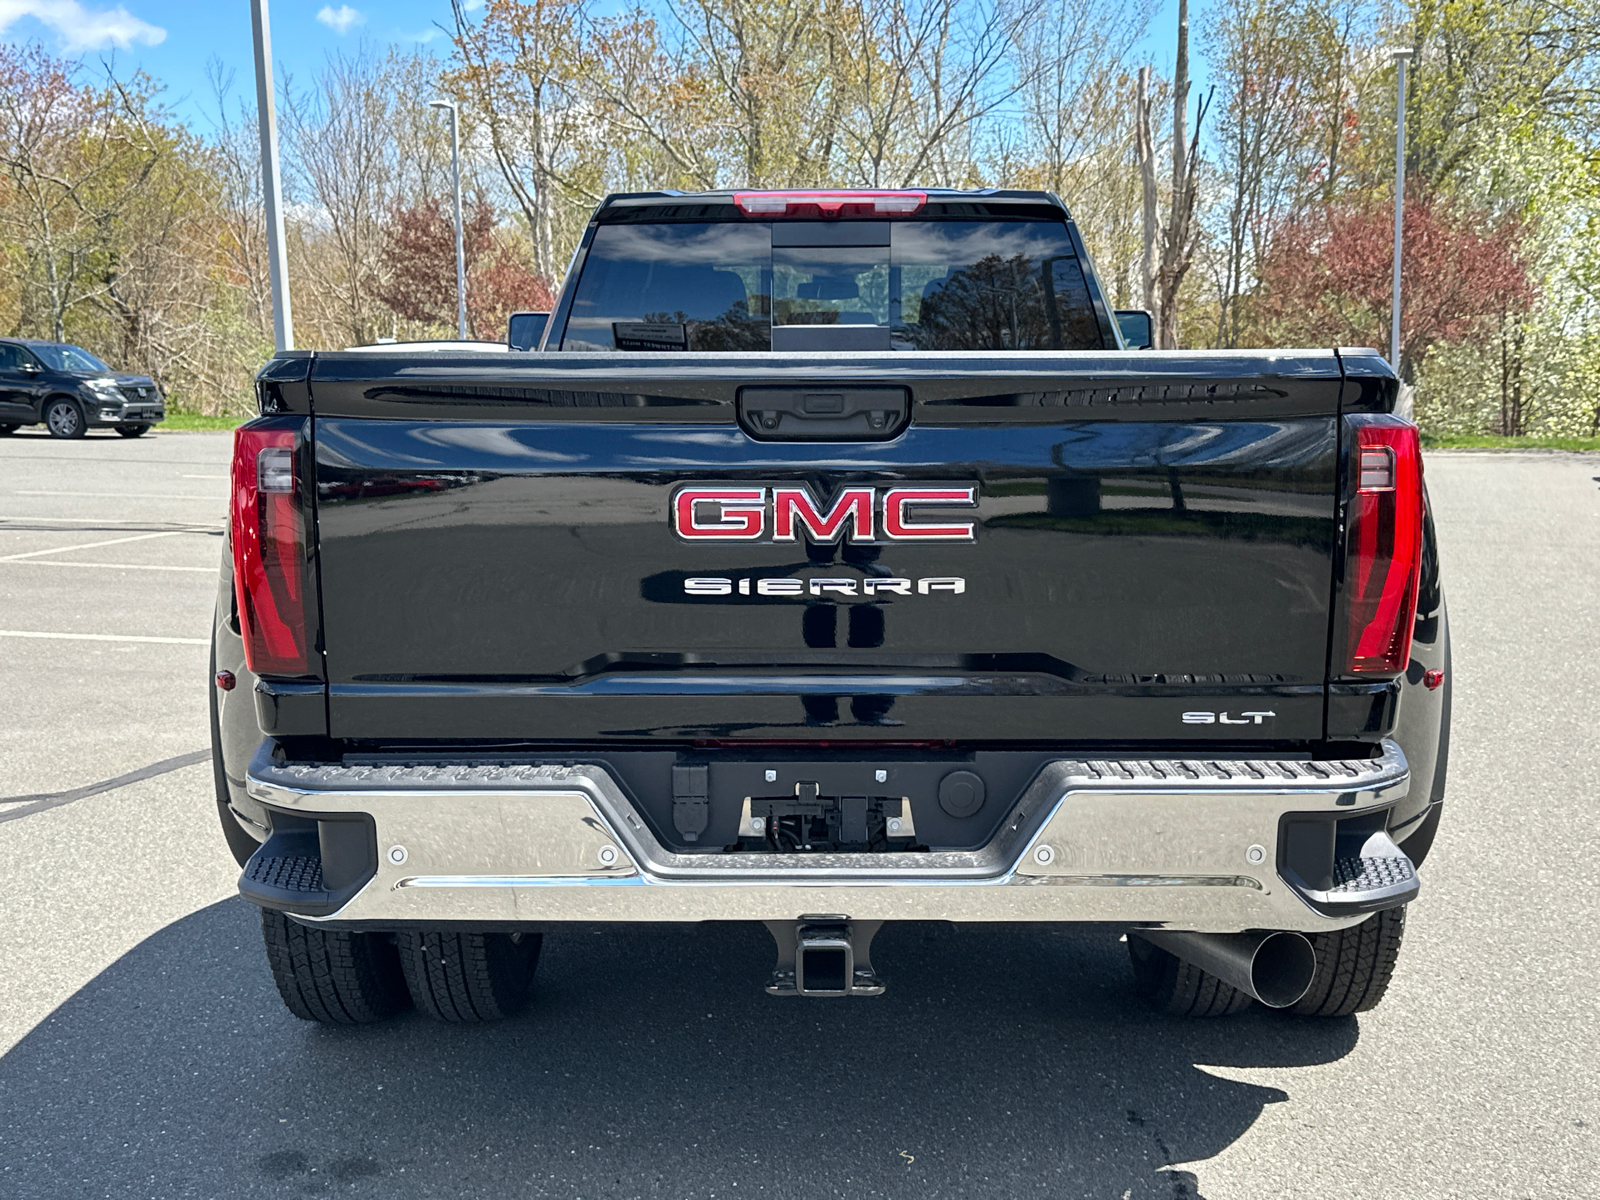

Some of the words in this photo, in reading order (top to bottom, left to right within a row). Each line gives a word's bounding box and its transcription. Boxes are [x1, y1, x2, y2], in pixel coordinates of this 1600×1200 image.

[672, 485, 977, 542] GMC
[683, 576, 967, 597] SIERRA
[1181, 710, 1277, 725] SLT
